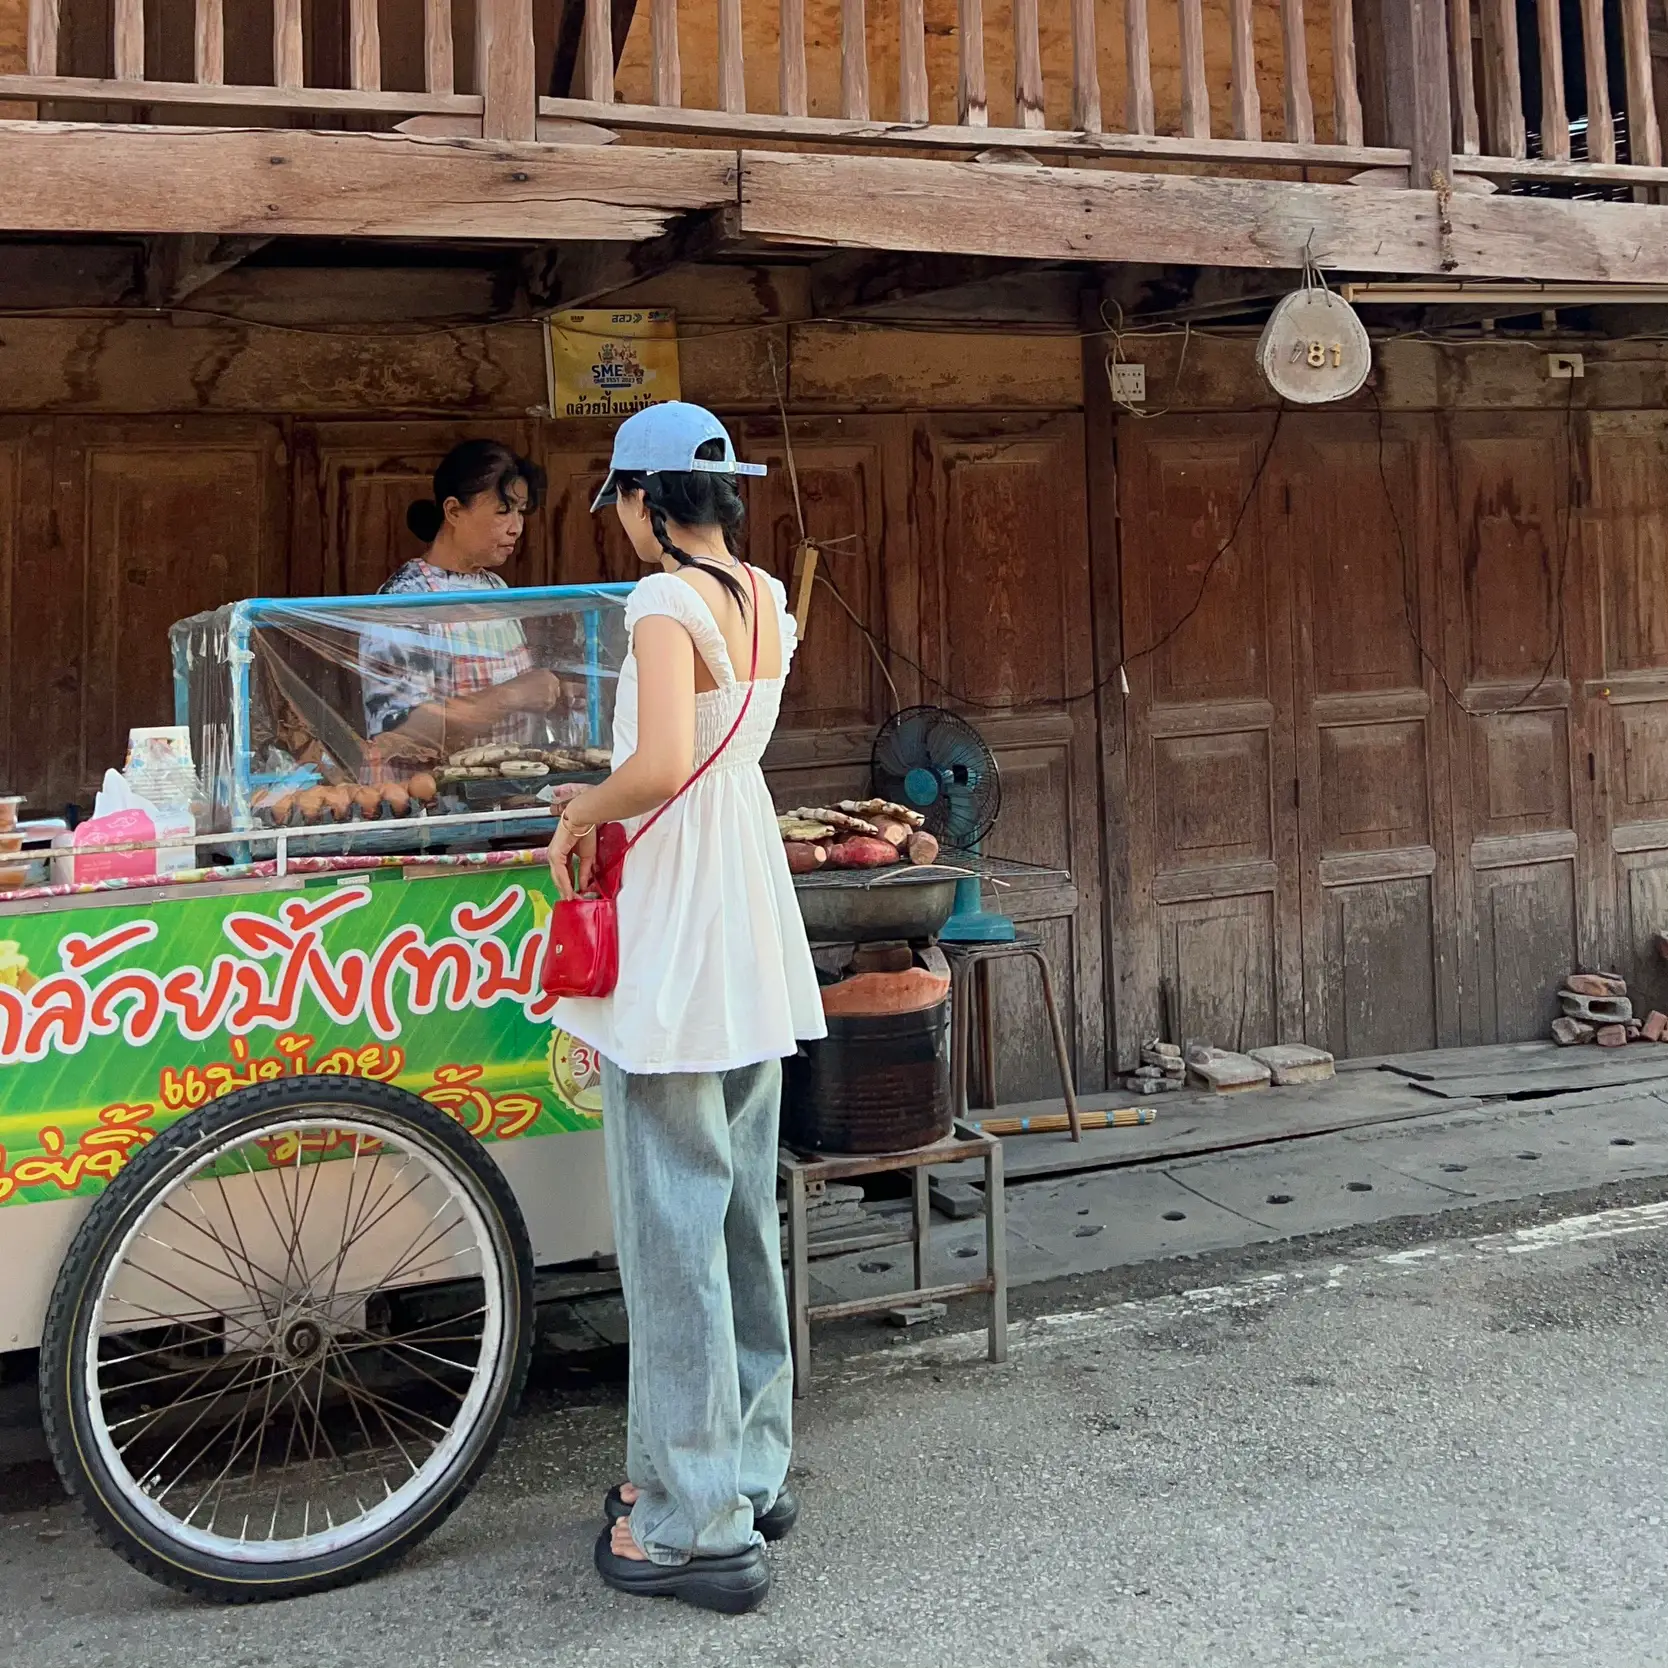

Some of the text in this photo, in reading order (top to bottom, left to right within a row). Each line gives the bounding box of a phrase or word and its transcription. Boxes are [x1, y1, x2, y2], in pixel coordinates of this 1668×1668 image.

[0, 887, 560, 1060] ล้วยปิ้ง(ทับ
